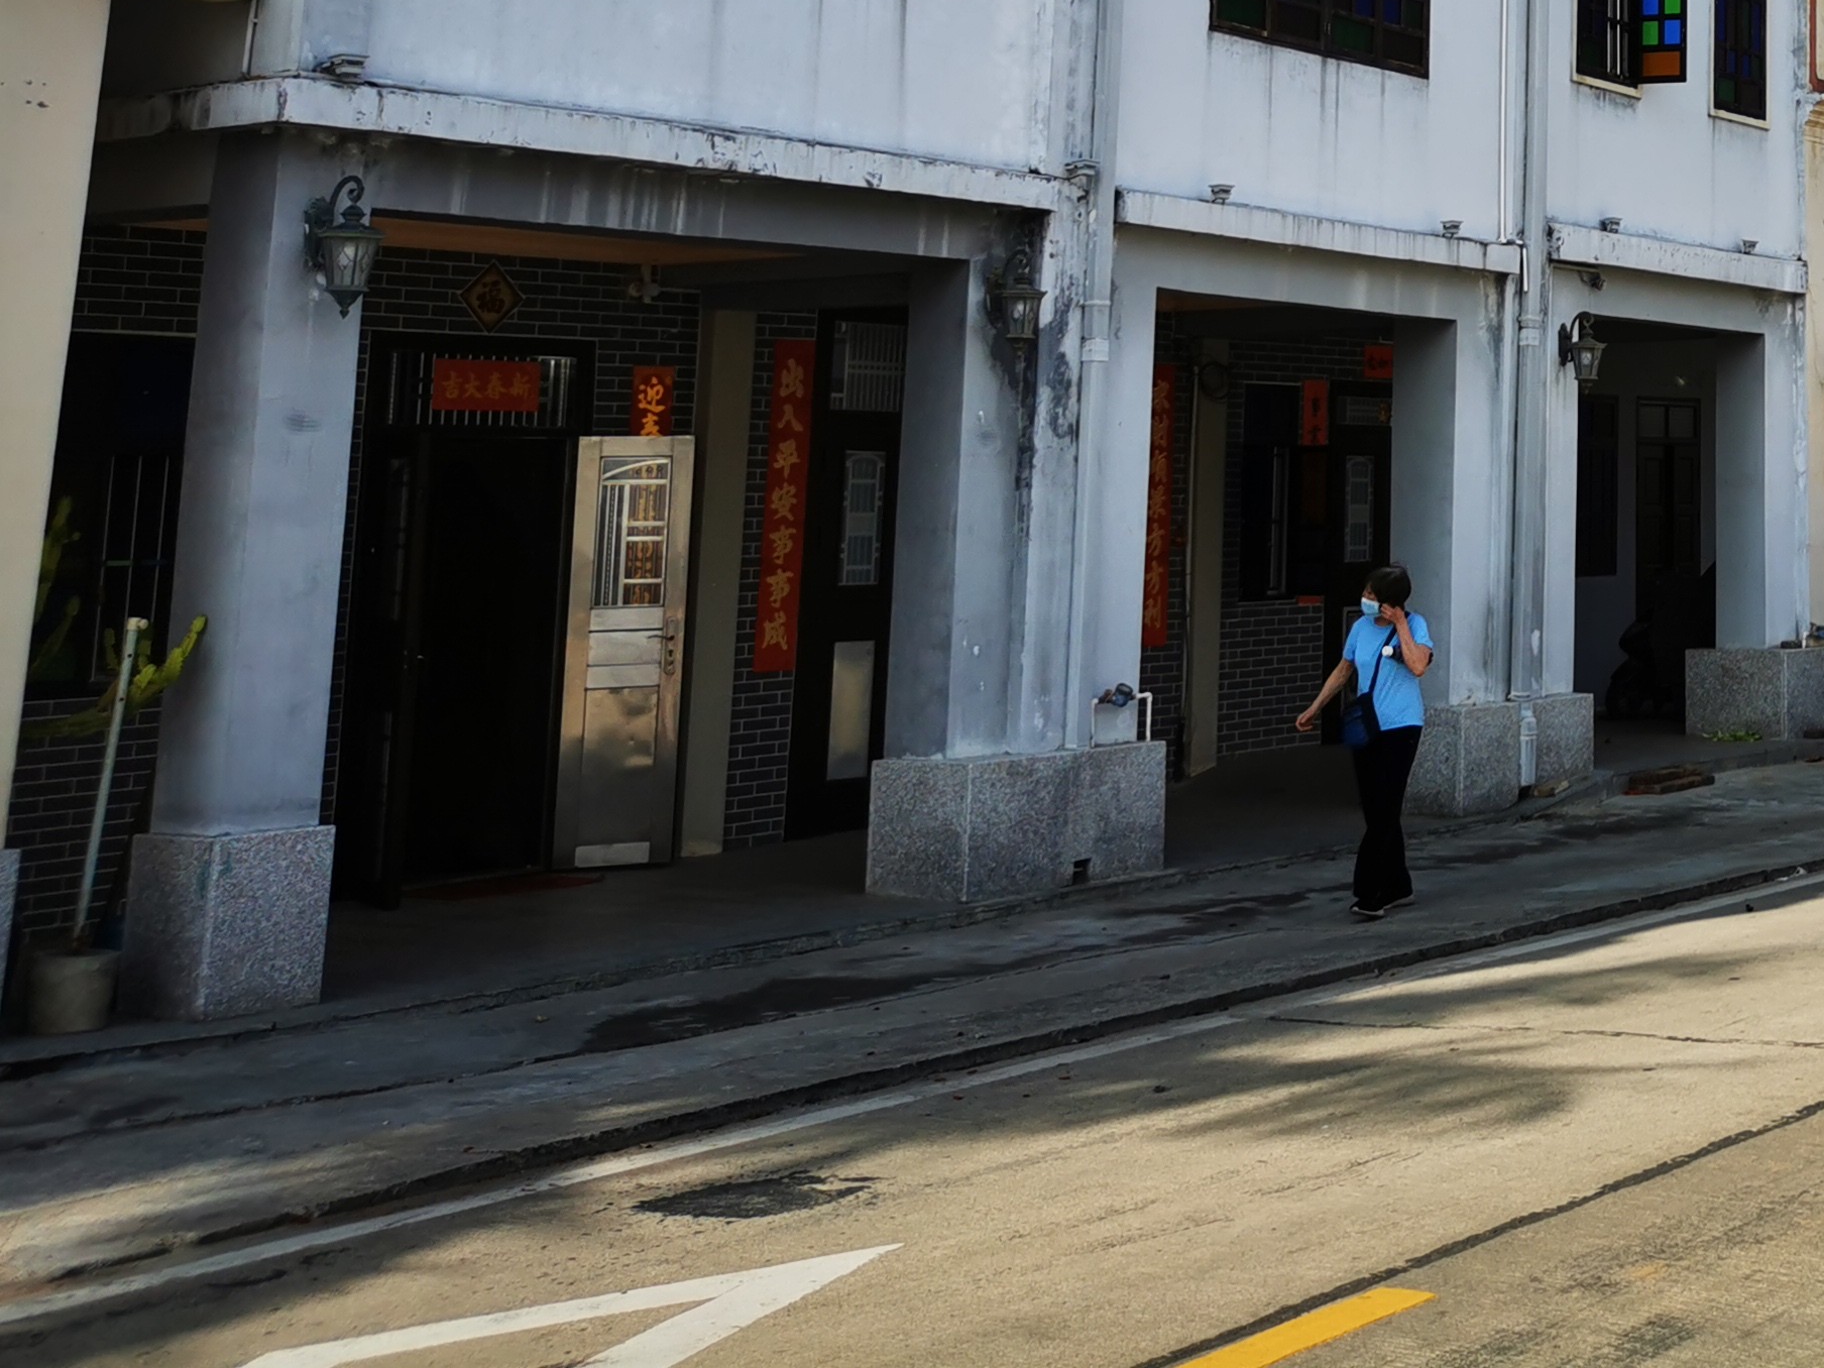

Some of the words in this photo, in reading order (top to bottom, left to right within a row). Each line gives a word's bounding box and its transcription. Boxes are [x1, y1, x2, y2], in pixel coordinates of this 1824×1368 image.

[476, 279, 506, 314] 福
[761, 357, 805, 651] 出入平安事事成
